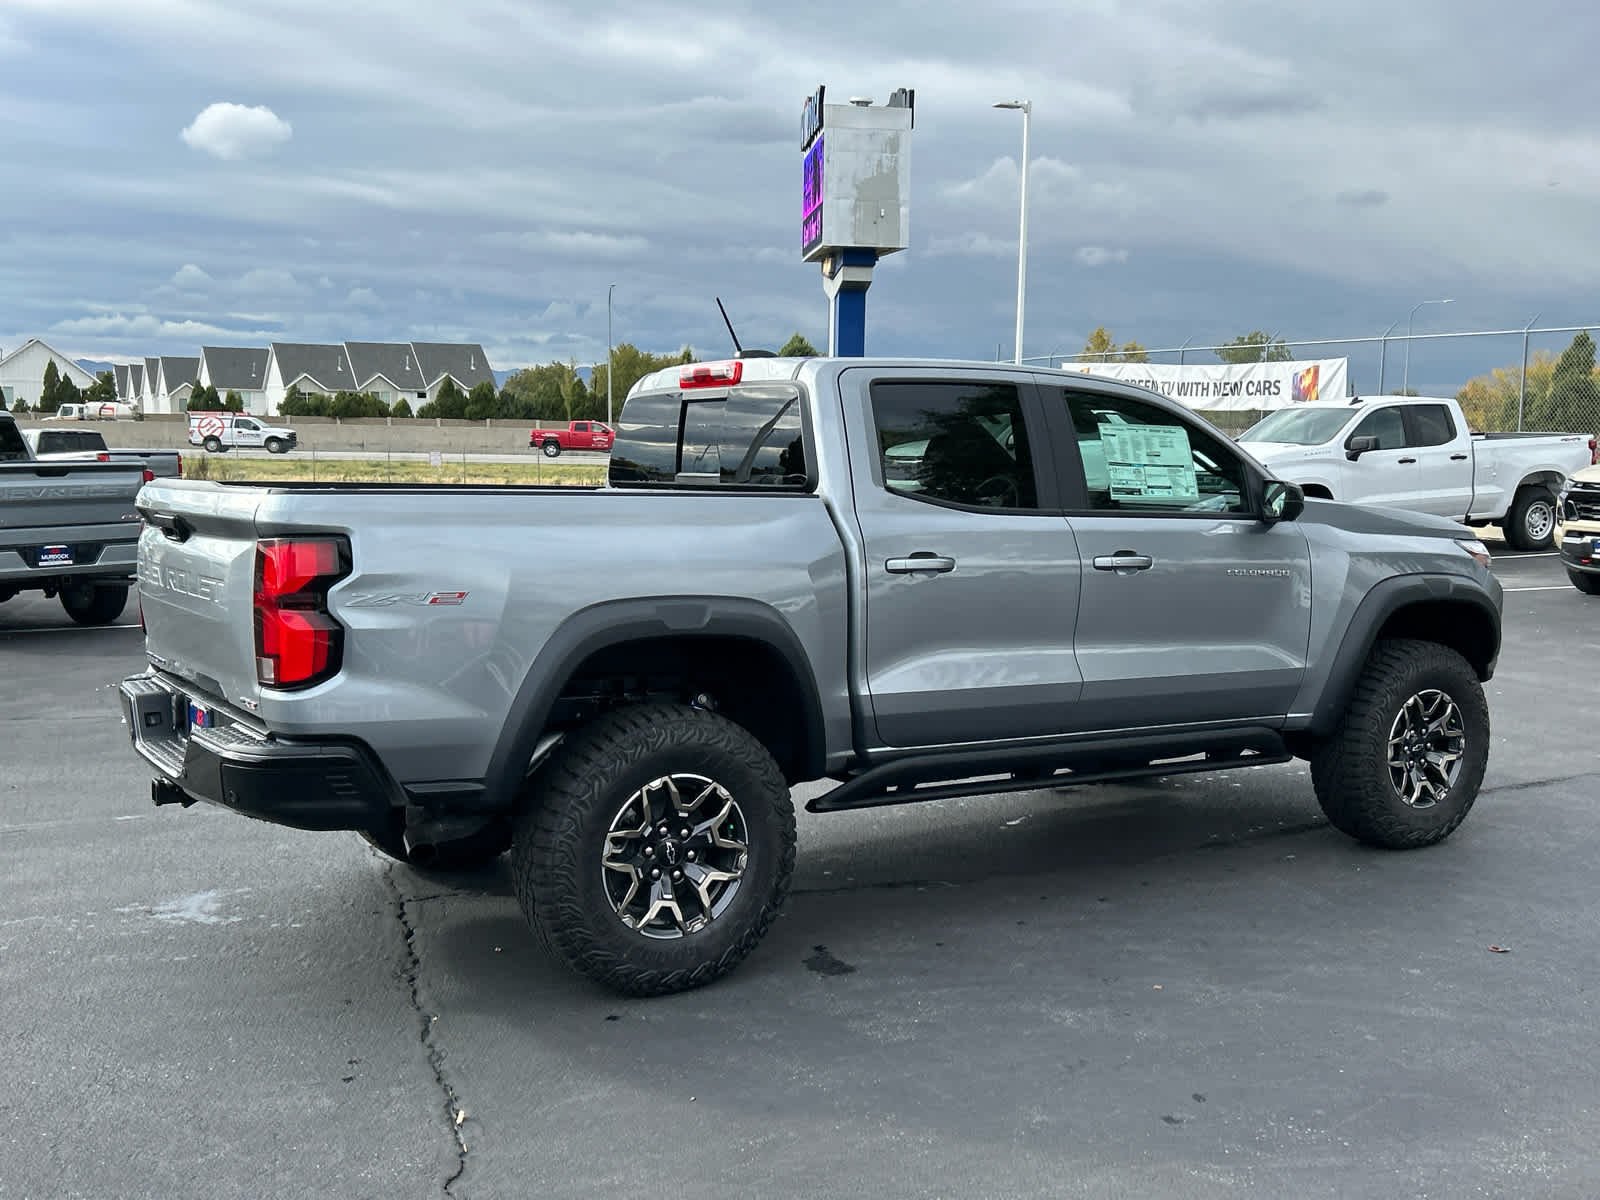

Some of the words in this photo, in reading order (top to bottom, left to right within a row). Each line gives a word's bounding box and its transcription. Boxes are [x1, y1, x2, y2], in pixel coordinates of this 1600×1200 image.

[1160, 381, 1175, 395] TV
[1177, 381, 1209, 396] WITH
[1213, 381, 1243, 397] NEW
[1246, 380, 1281, 396] CARS
